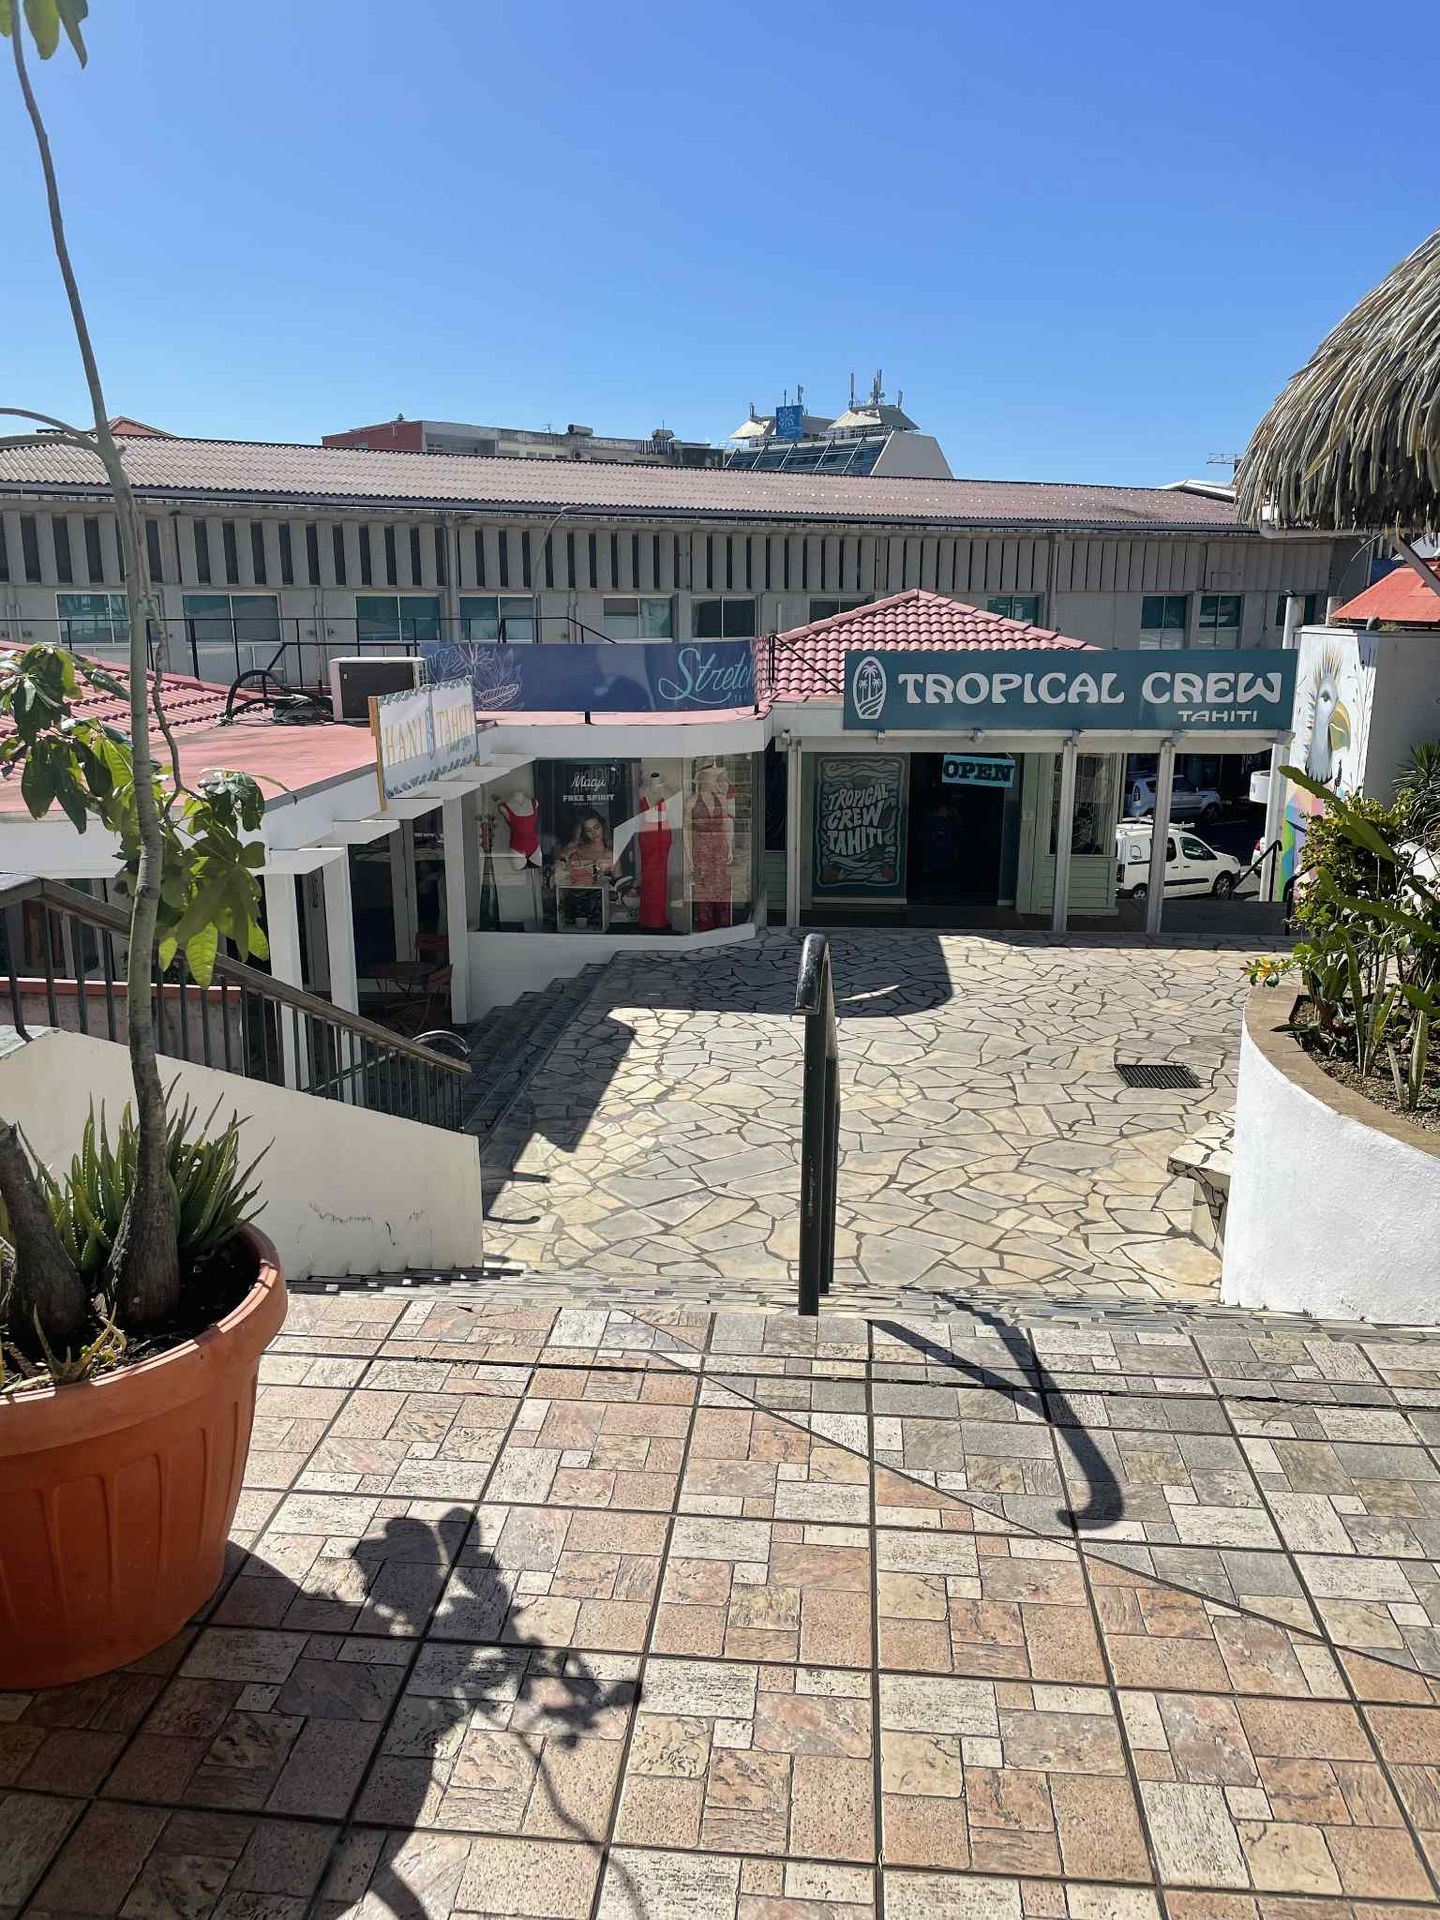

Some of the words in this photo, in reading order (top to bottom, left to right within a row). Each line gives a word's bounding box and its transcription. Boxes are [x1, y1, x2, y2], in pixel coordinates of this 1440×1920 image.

[658, 647, 754, 704] Stretc
[898, 672, 1125, 704] TROPICAL
[1142, 672, 1283, 704] CREW
[1177, 709, 1258, 723] TAHITI
[943, 759, 1015, 781] OPEN
[562, 794, 585, 802] FREE
[586, 794, 615, 802] SPIRIT
[827, 783, 889, 811] TROPICAL
[827, 800, 885, 830] CREW
[827, 826, 883, 856] TAHITI
